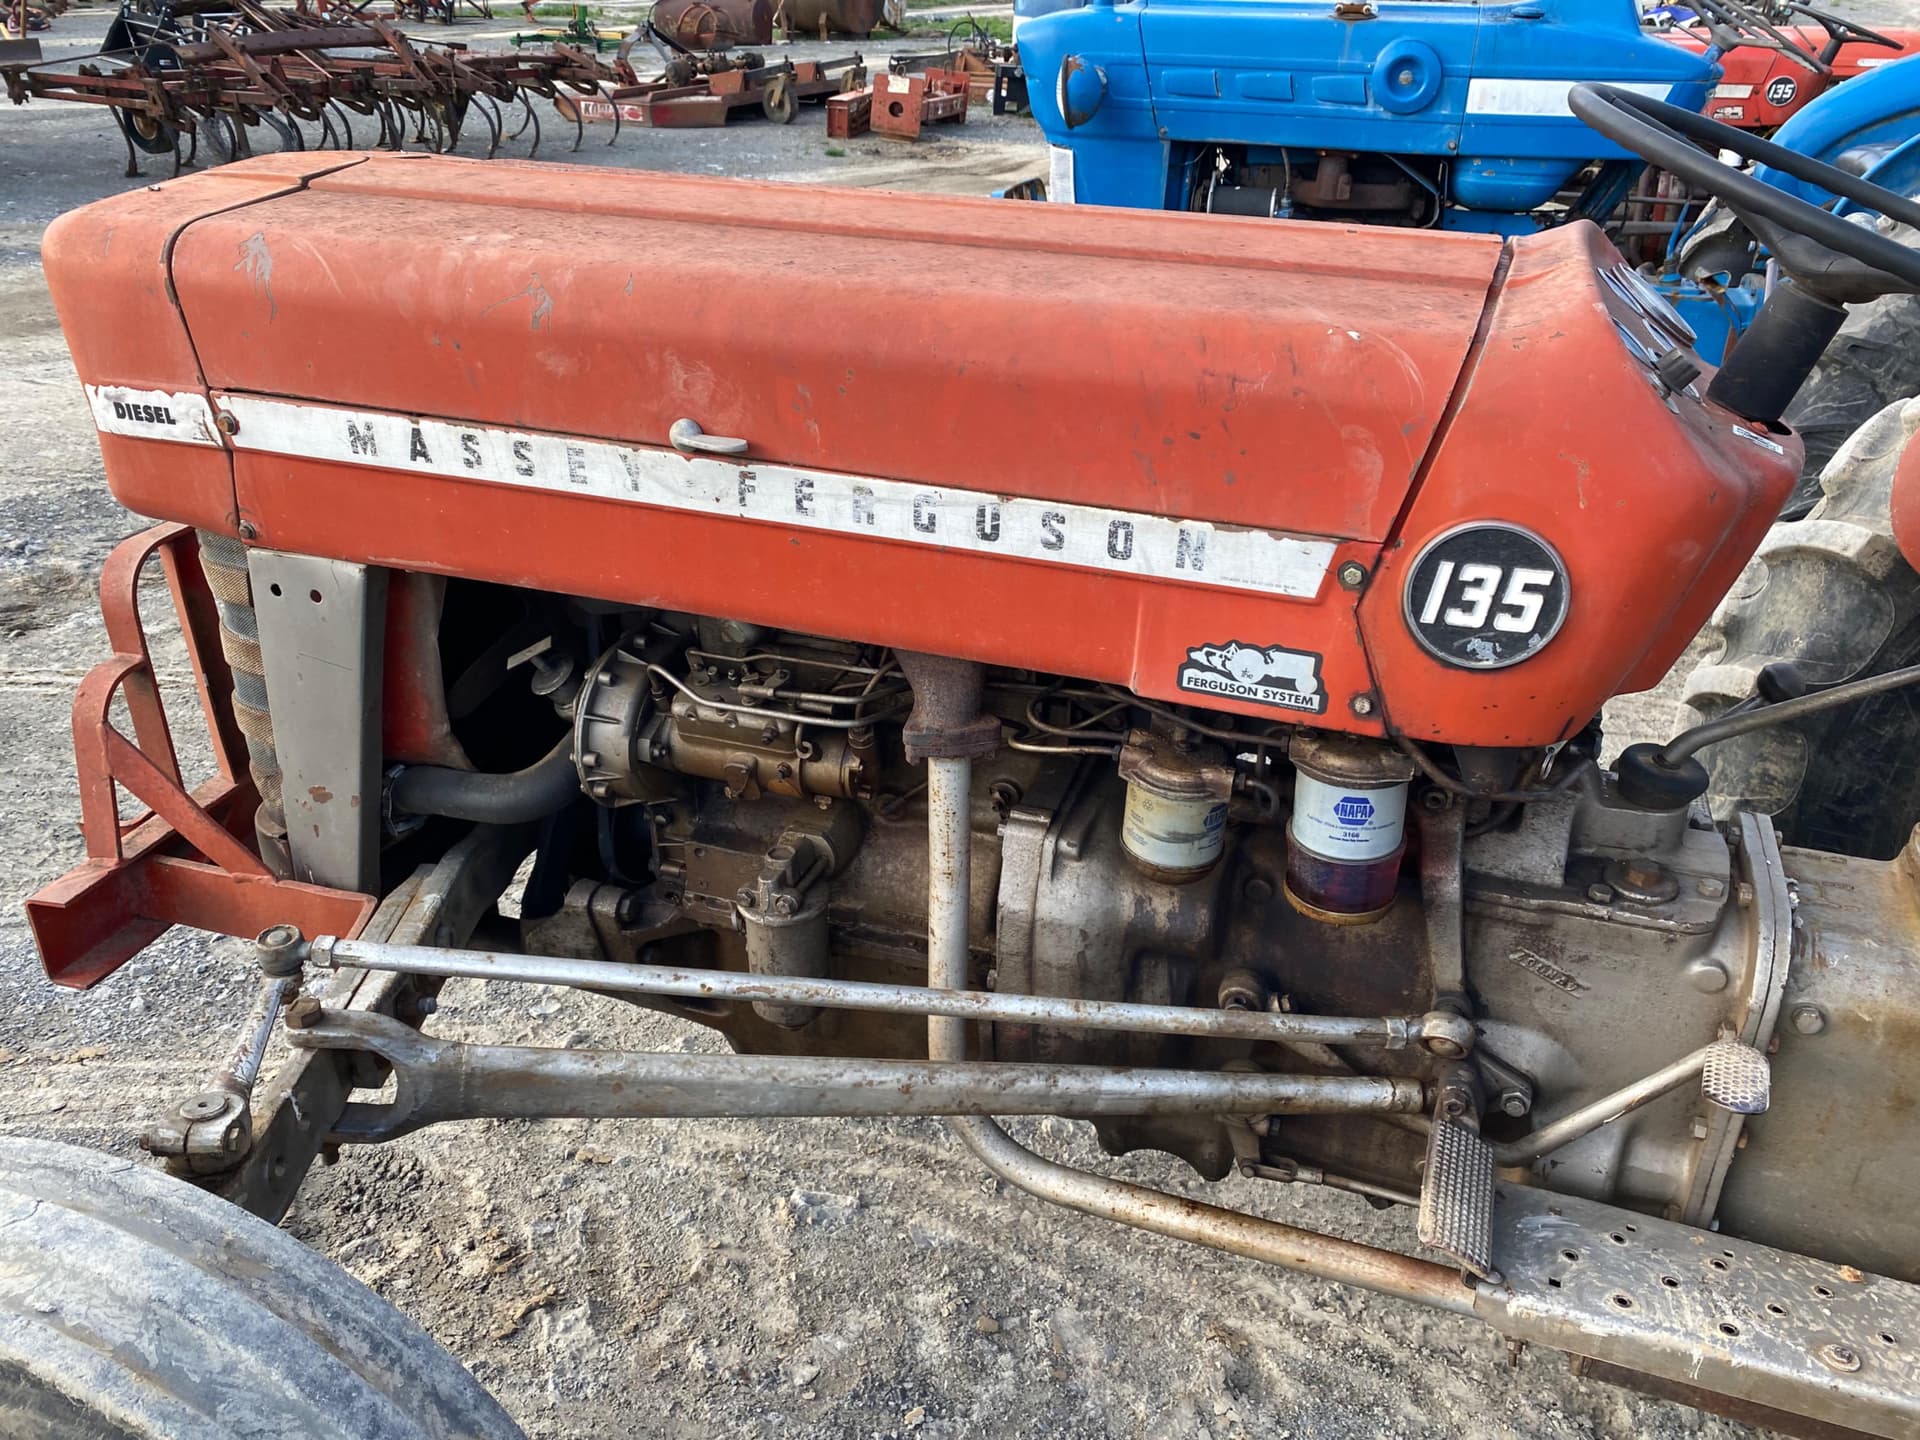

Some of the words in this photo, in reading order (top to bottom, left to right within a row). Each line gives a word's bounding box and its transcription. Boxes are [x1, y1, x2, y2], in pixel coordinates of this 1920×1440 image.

[1768, 84, 1795, 99] 135
[113, 402, 176, 425] DIESEL
[346, 419, 641, 492] MASSEY
[738, 470, 1207, 571] FERGUSON
[1420, 561, 1554, 633] 135
[1187, 676, 1258, 697] FERGUSON
[1262, 689, 1314, 707] SYSTEM
[1340, 804, 1368, 819] NAPA
